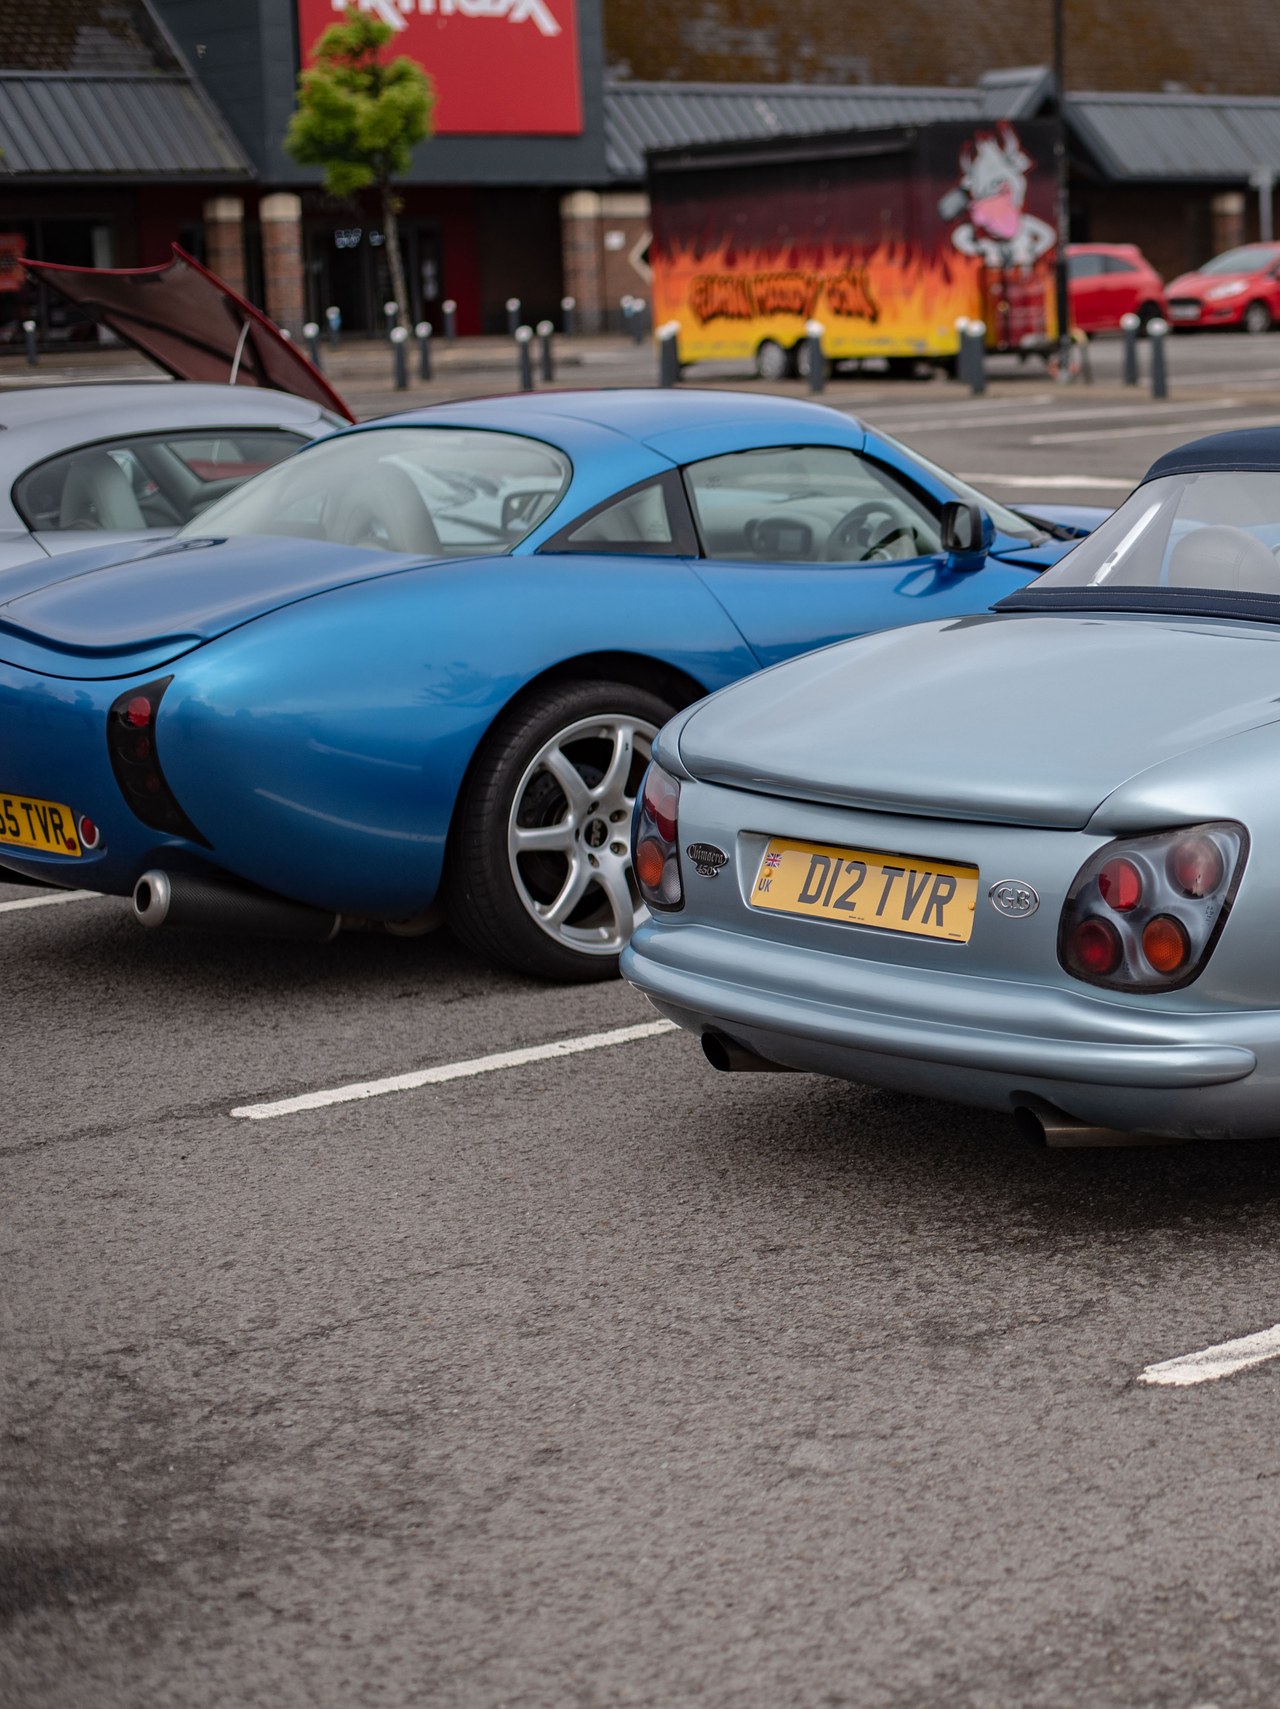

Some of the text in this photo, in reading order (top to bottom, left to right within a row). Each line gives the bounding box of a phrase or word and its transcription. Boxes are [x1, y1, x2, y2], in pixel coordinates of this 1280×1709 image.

[20, 802, 70, 846] TVR
[758, 877, 772, 893] UK
[797, 854, 957, 927] D12 TVR
[997, 886, 1031, 911] GB
